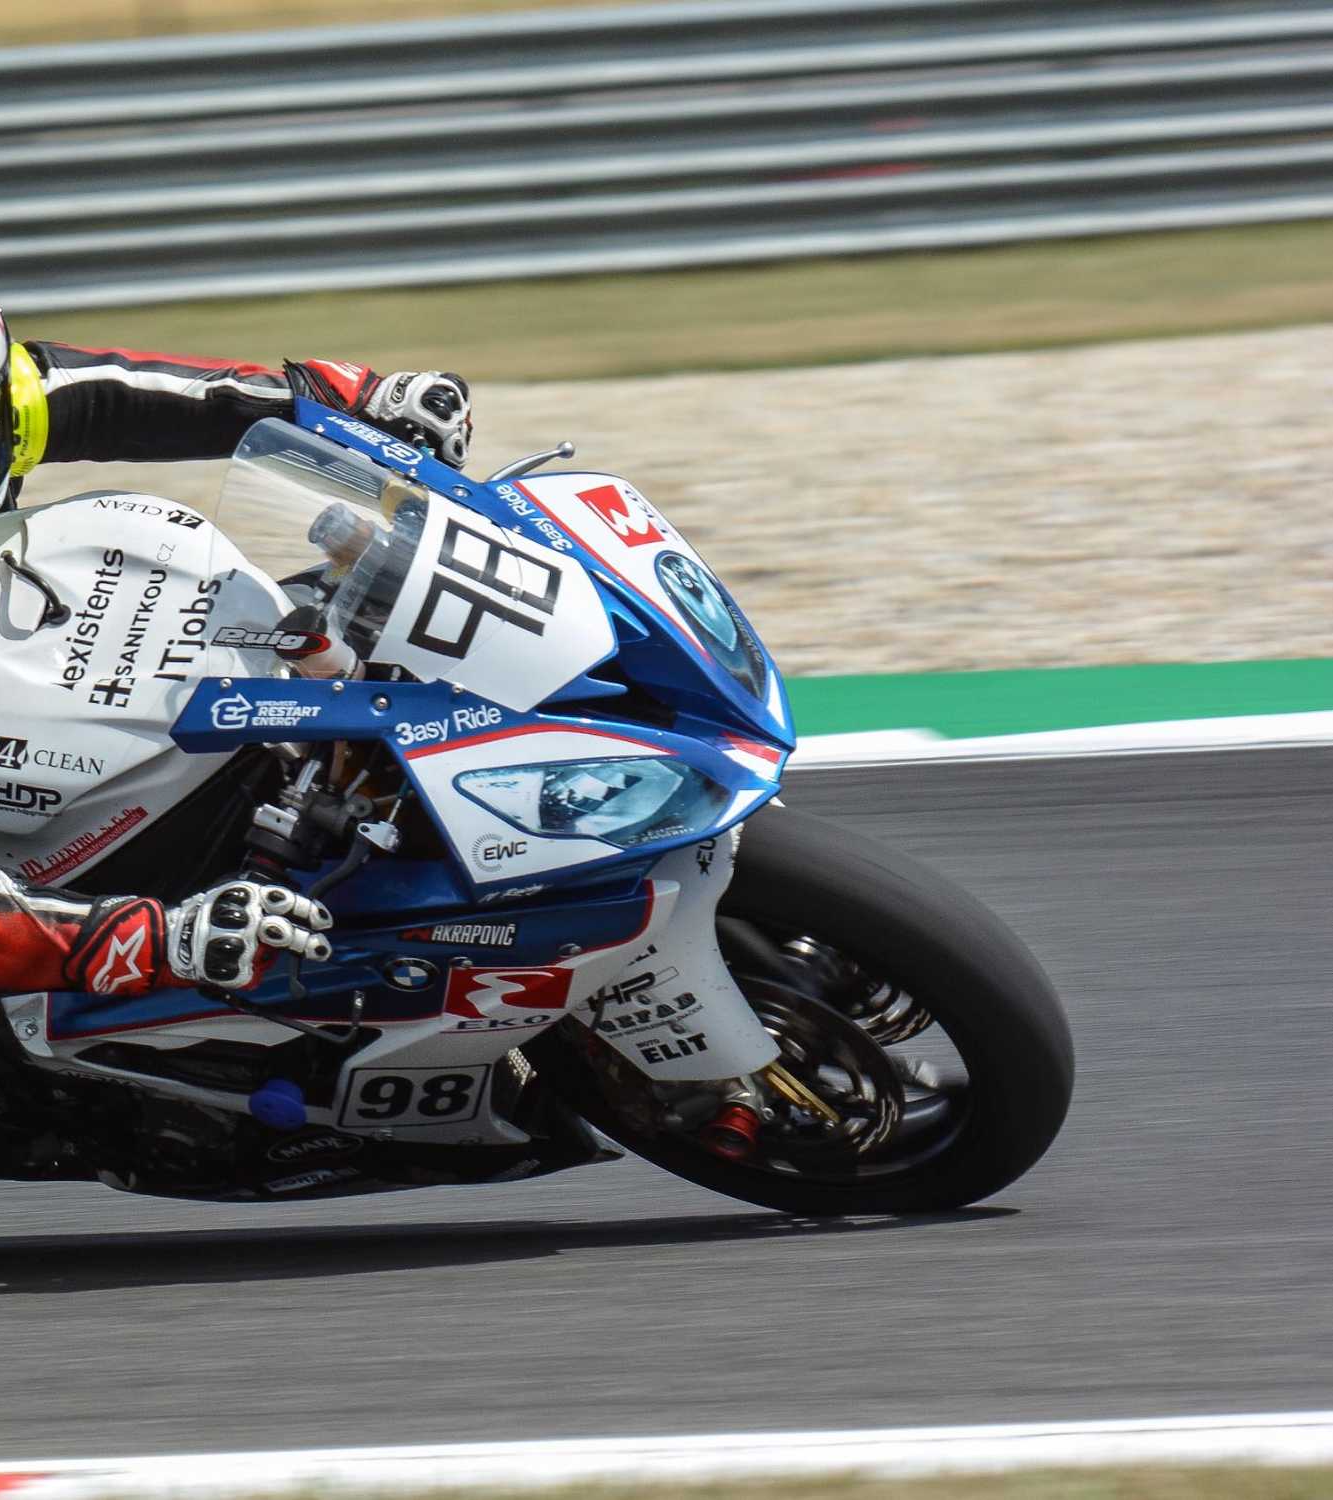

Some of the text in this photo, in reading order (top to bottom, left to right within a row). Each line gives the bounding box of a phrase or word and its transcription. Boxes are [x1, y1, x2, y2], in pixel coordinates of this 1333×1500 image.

[92, 498, 162, 517] CLEAN
[496, 483, 535, 517] Ride
[210, 626, 309, 650] Puig
[251, 716, 301, 726] ENERGY
[257, 706, 322, 717] RESTART
[453, 704, 503, 732] Ride
[34, 749, 106, 776] CLEAN
[483, 841, 528, 861] EWC
[457, 1014, 551, 1030] EKO
[640, 1032, 708, 1064] ELIT
[356, 1073, 476, 1120] 98
